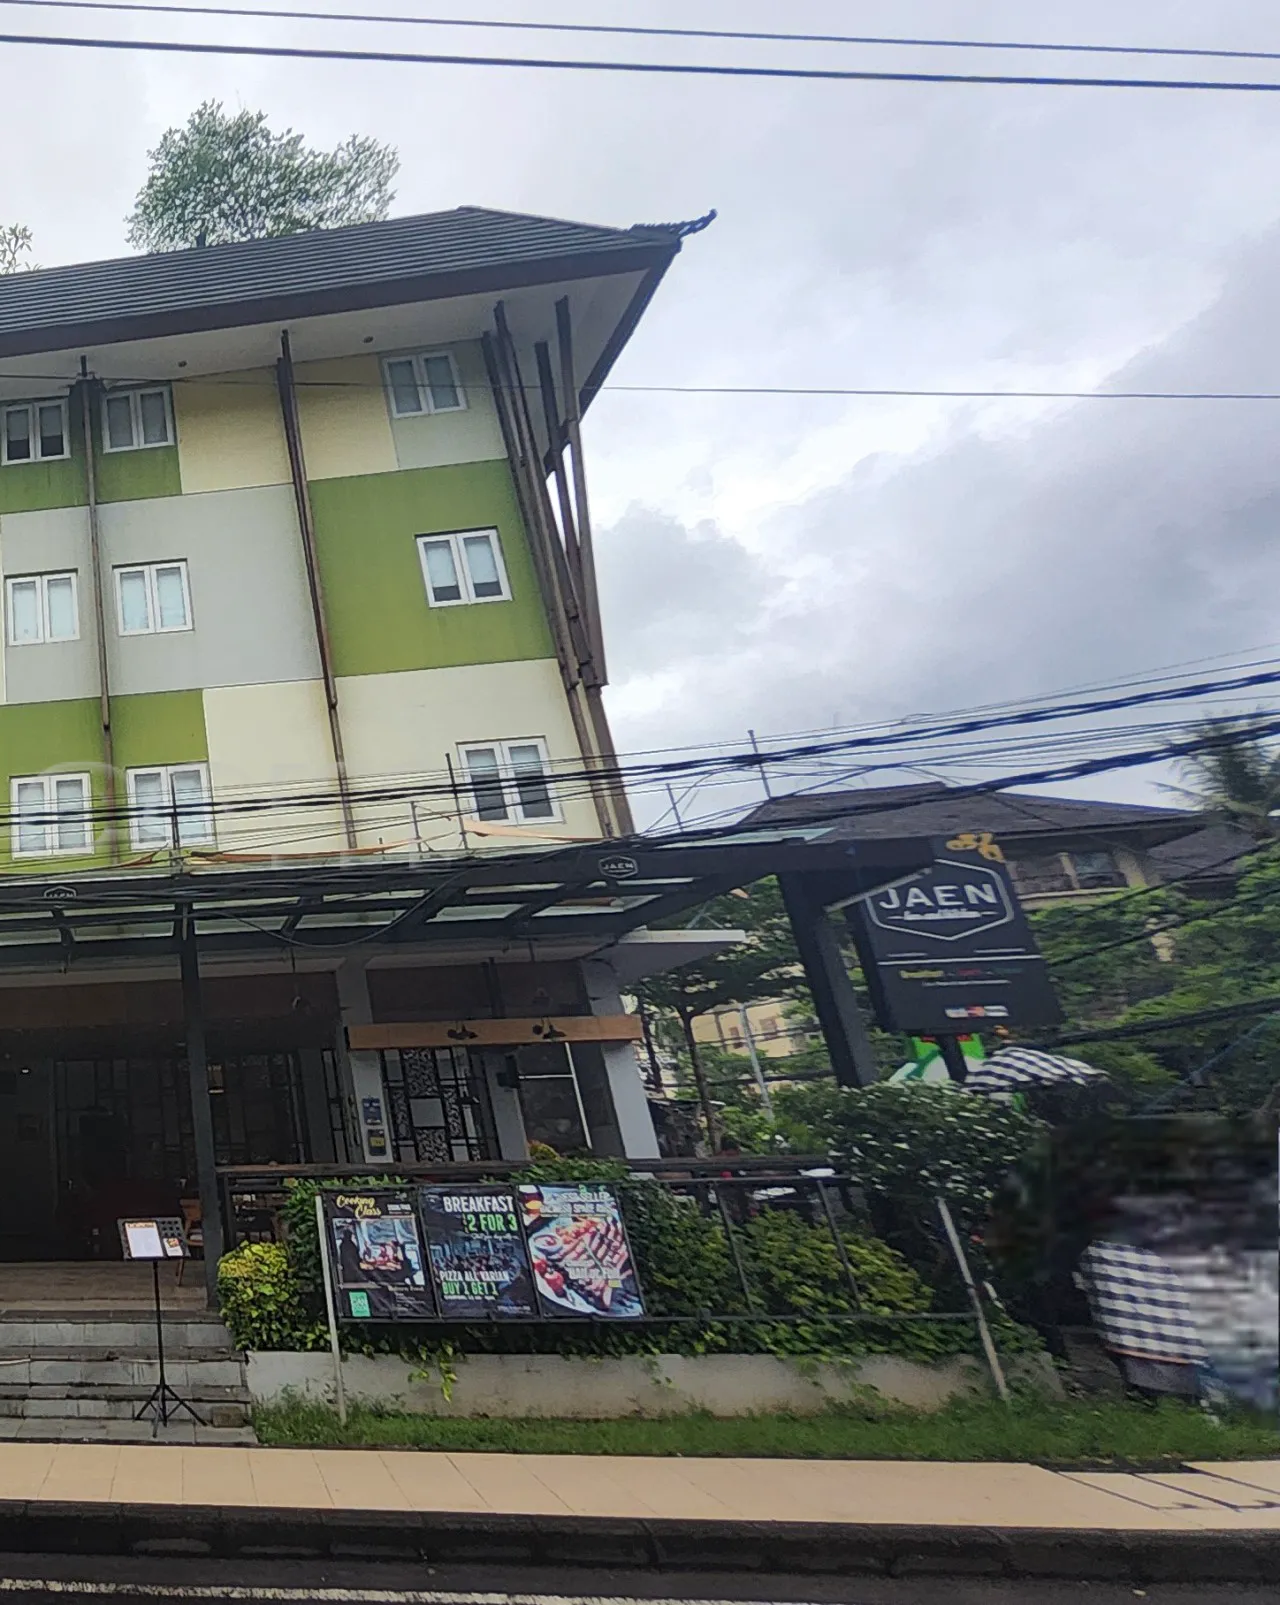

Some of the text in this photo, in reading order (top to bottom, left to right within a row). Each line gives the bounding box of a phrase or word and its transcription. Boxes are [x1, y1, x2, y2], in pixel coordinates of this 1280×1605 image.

[879, 883, 998, 909] JAEN
[336, 1195, 375, 1209] Cooking
[442, 1195, 514, 1213] BREAKFAST
[355, 1205, 381, 1221] Class
[467, 1213, 518, 1232] 2 FOR 3
[439, 1270, 463, 1281] PIZZA
[442, 1281, 461, 1295] BUY
[471, 1281, 489, 1295] GET
[490, 1281, 499, 1296] 1
